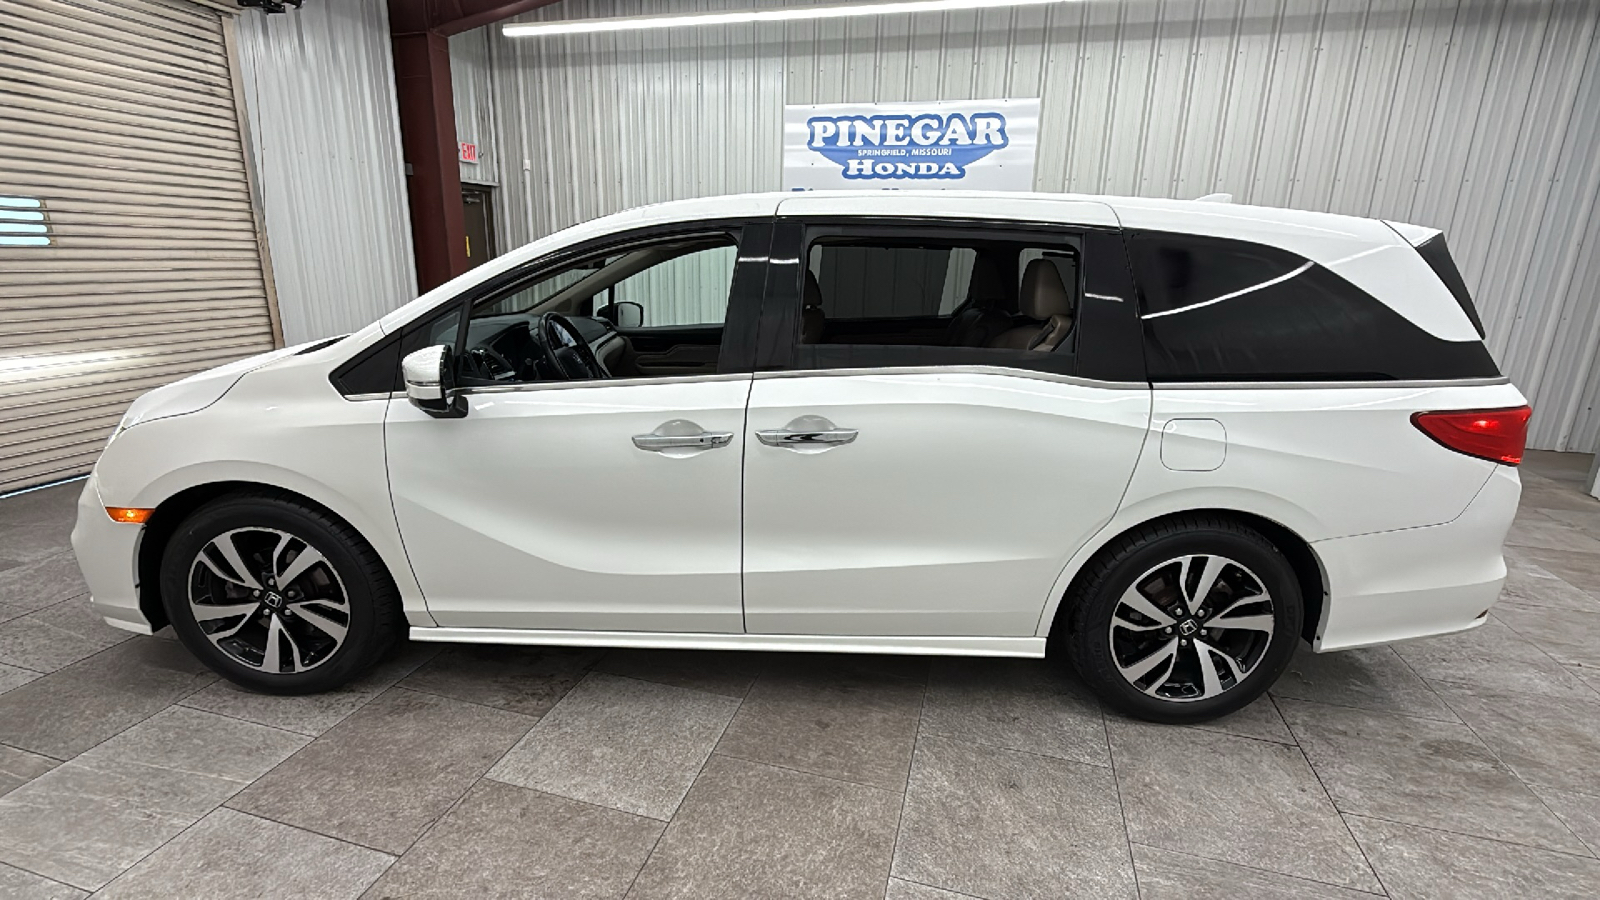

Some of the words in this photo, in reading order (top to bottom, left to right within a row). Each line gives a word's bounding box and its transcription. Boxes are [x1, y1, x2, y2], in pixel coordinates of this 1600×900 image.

[810, 116, 1005, 148] PINEGAR
[461, 142, 476, 160] EXIT
[857, 149, 910, 157] SPRINGFIELD,
[911, 147, 952, 156] MISSOURI
[846, 159, 962, 176] HONDA
